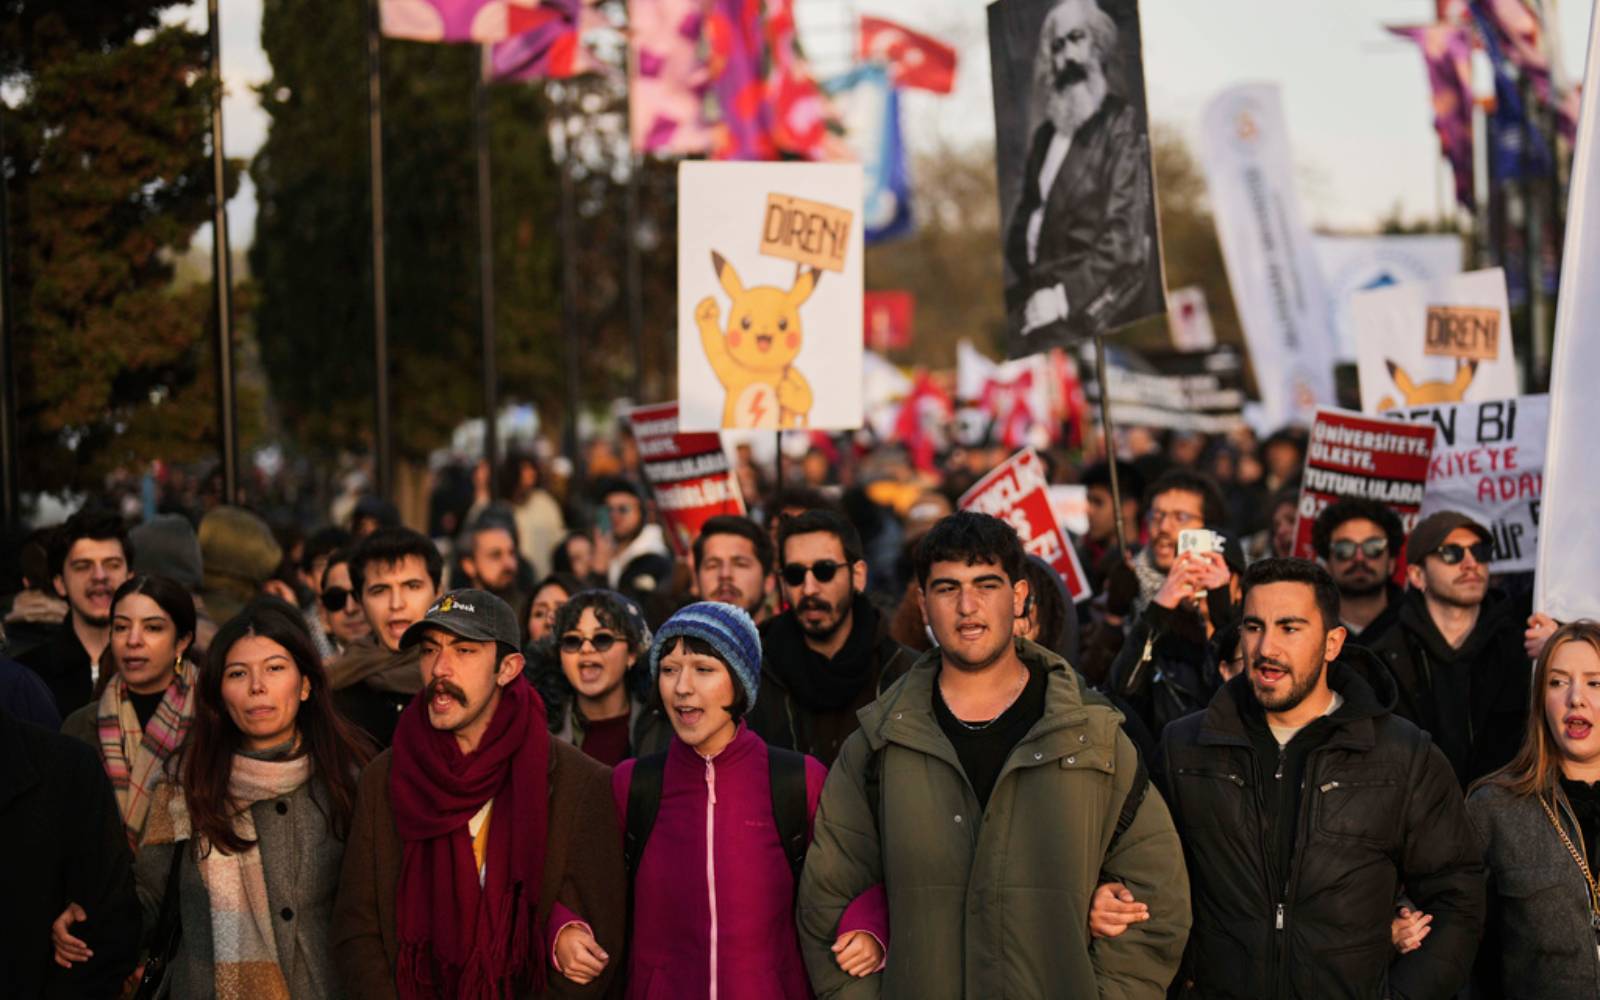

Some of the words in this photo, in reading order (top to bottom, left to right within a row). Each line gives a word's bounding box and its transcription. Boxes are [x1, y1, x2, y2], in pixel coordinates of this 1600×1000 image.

[764, 198, 847, 260] DİREN!
[1427, 306, 1497, 351] DİREN!
[1310, 441, 1376, 471] ÜLKEYE,
[1313, 419, 1430, 458] ÜNİVERSİTEYE,
[1428, 442, 1517, 481] KİYE'YE
[1304, 468, 1423, 505] TUTUKLULARA
[1476, 471, 1543, 505] ADA
